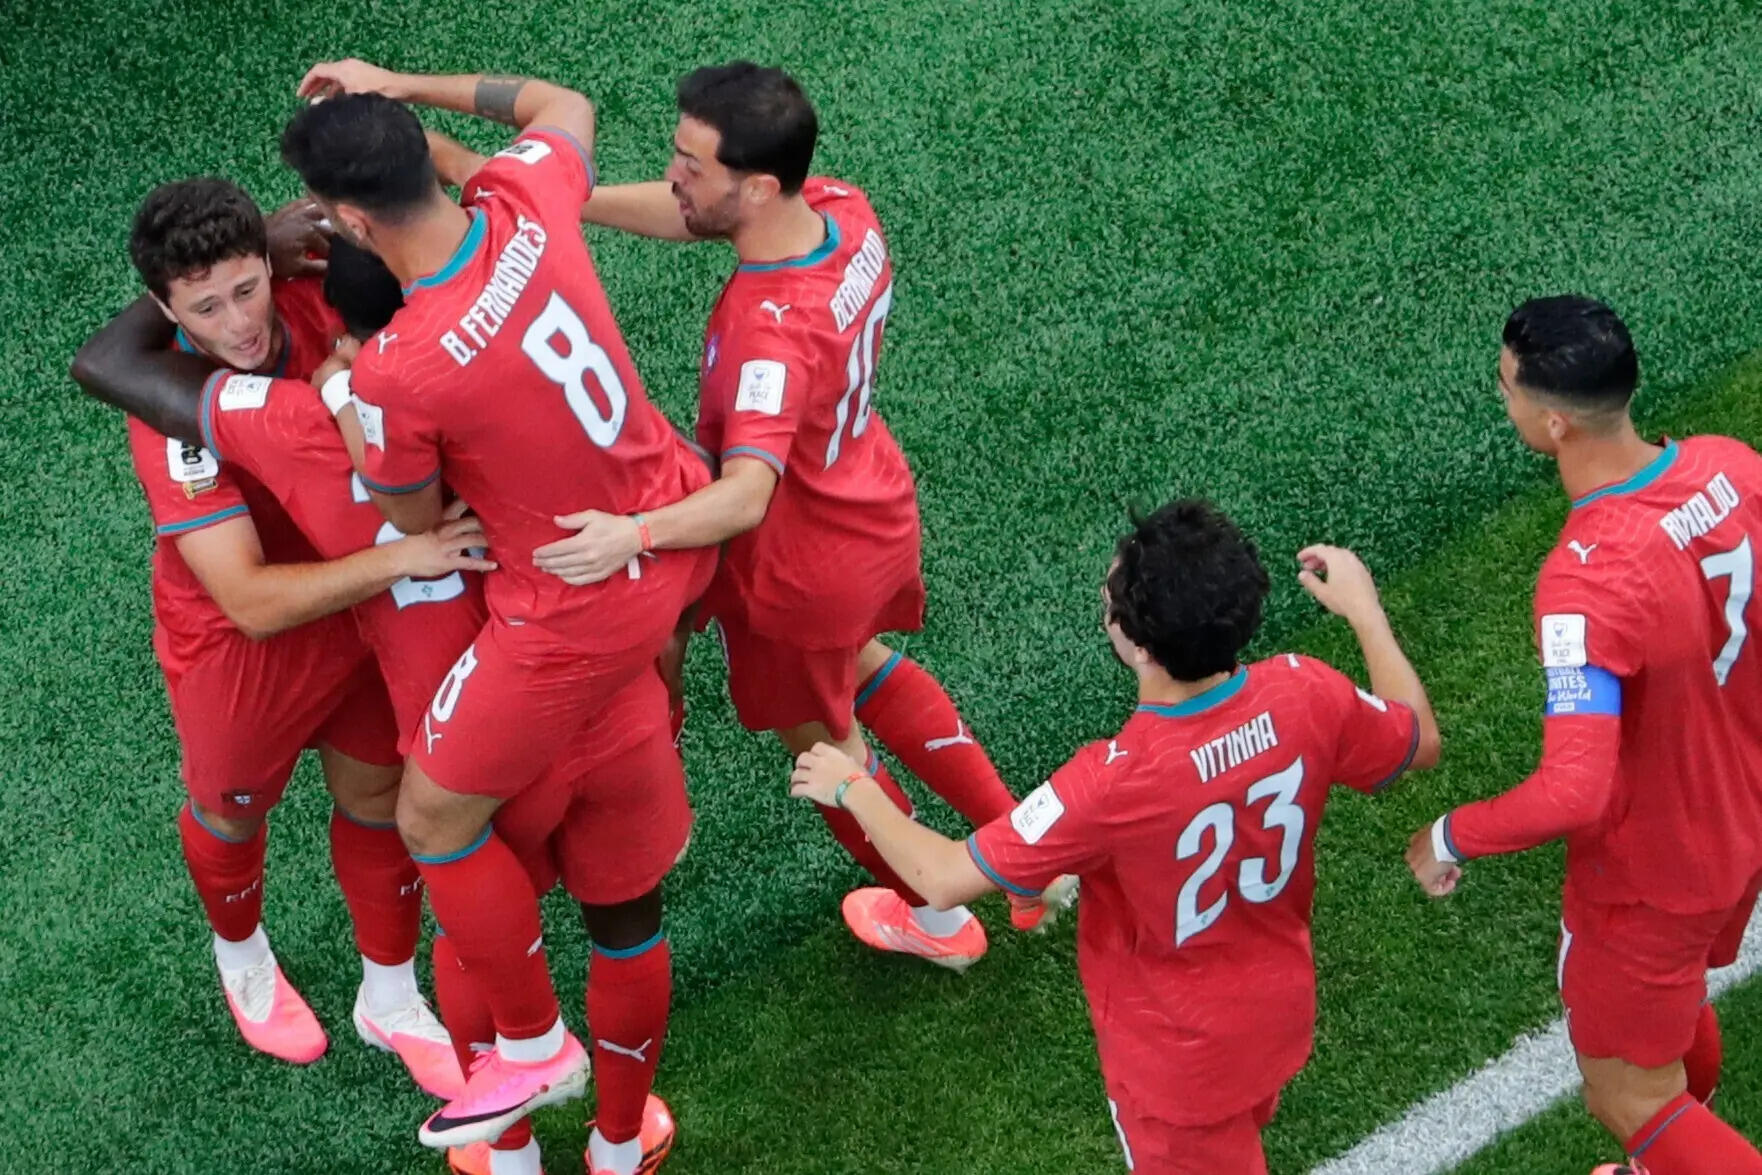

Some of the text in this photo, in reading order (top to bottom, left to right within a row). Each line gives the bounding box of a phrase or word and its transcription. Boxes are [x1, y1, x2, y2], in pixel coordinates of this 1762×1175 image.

[520, 289, 629, 449] 8
[432, 644, 477, 723] 8
[1700, 532, 1753, 687] 7
[1189, 711, 1279, 783] VITINHA
[1175, 753, 1305, 949] 23
